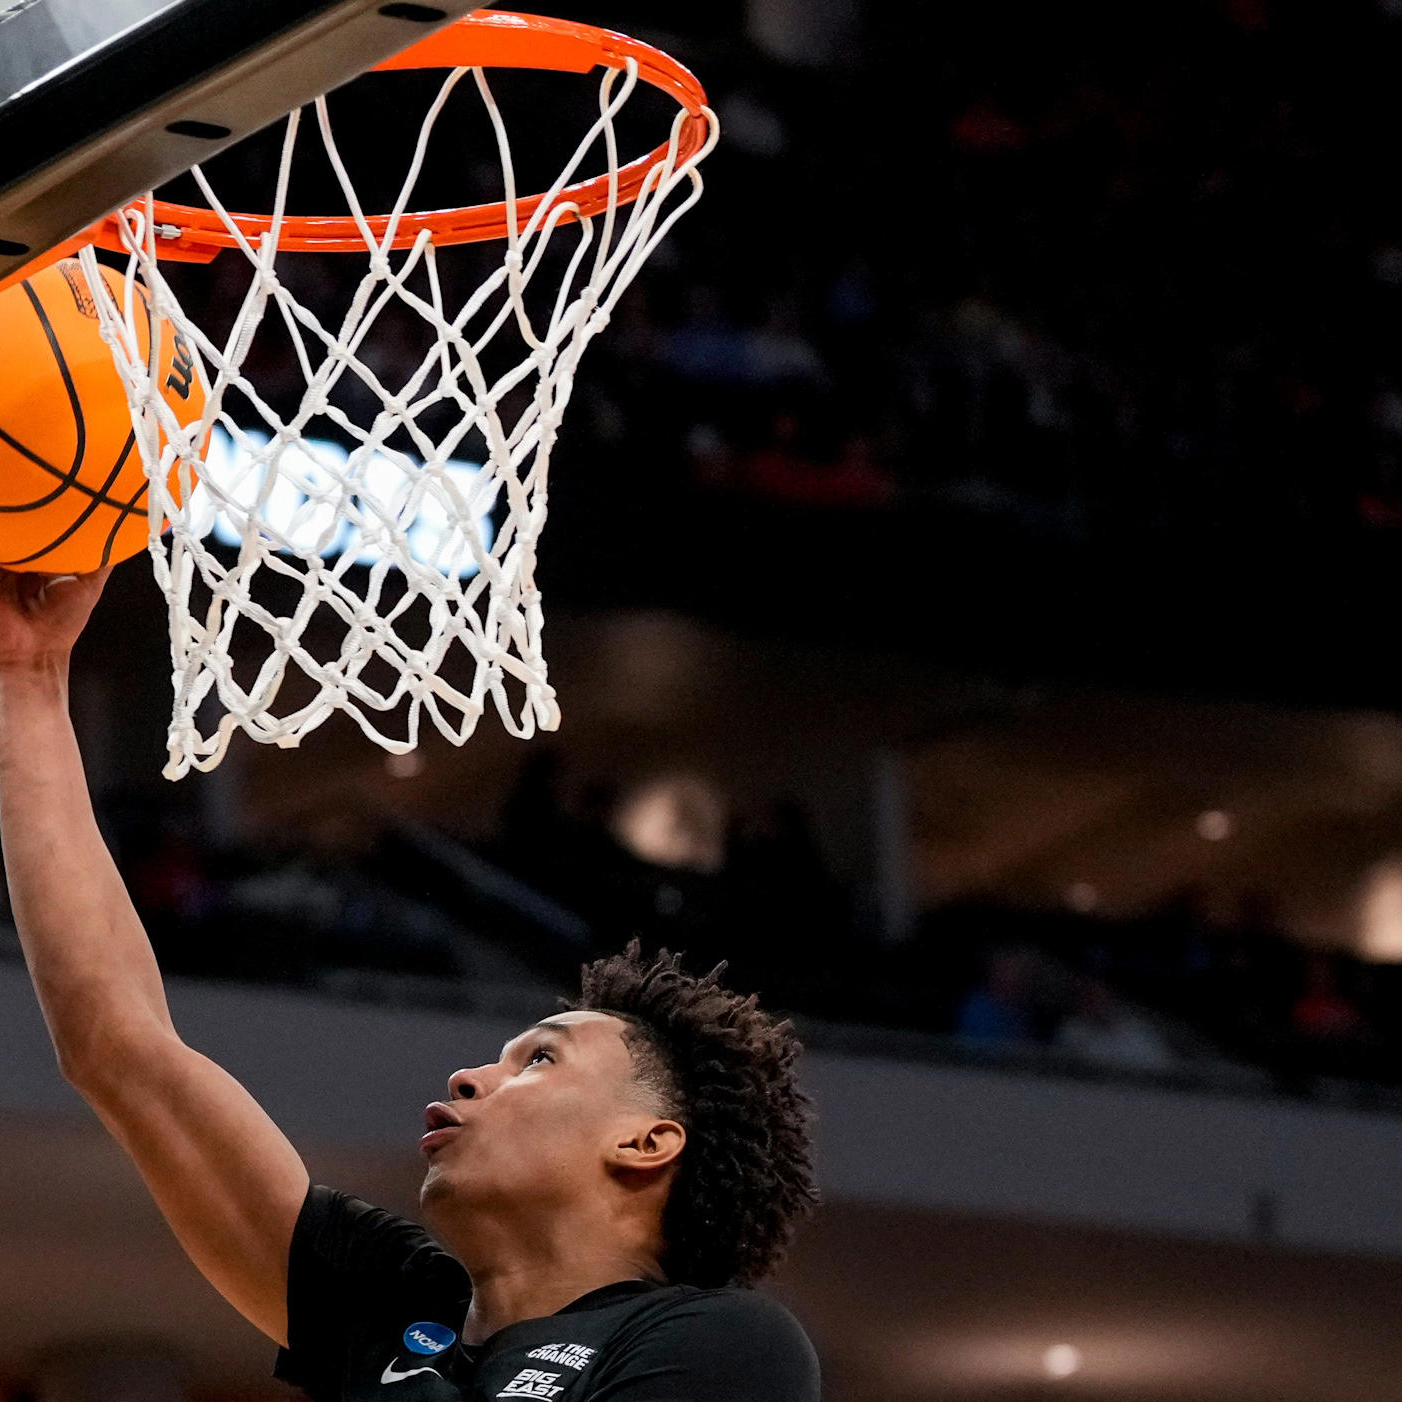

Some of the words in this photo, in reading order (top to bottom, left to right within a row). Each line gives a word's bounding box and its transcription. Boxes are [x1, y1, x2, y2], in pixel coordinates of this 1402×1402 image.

[409, 1330, 447, 1352] NCAA
[527, 1348, 590, 1371] CHANGE
[563, 1343, 595, 1359] THE
[514, 1368, 562, 1385] BIG
[502, 1380, 564, 1398] EAST
